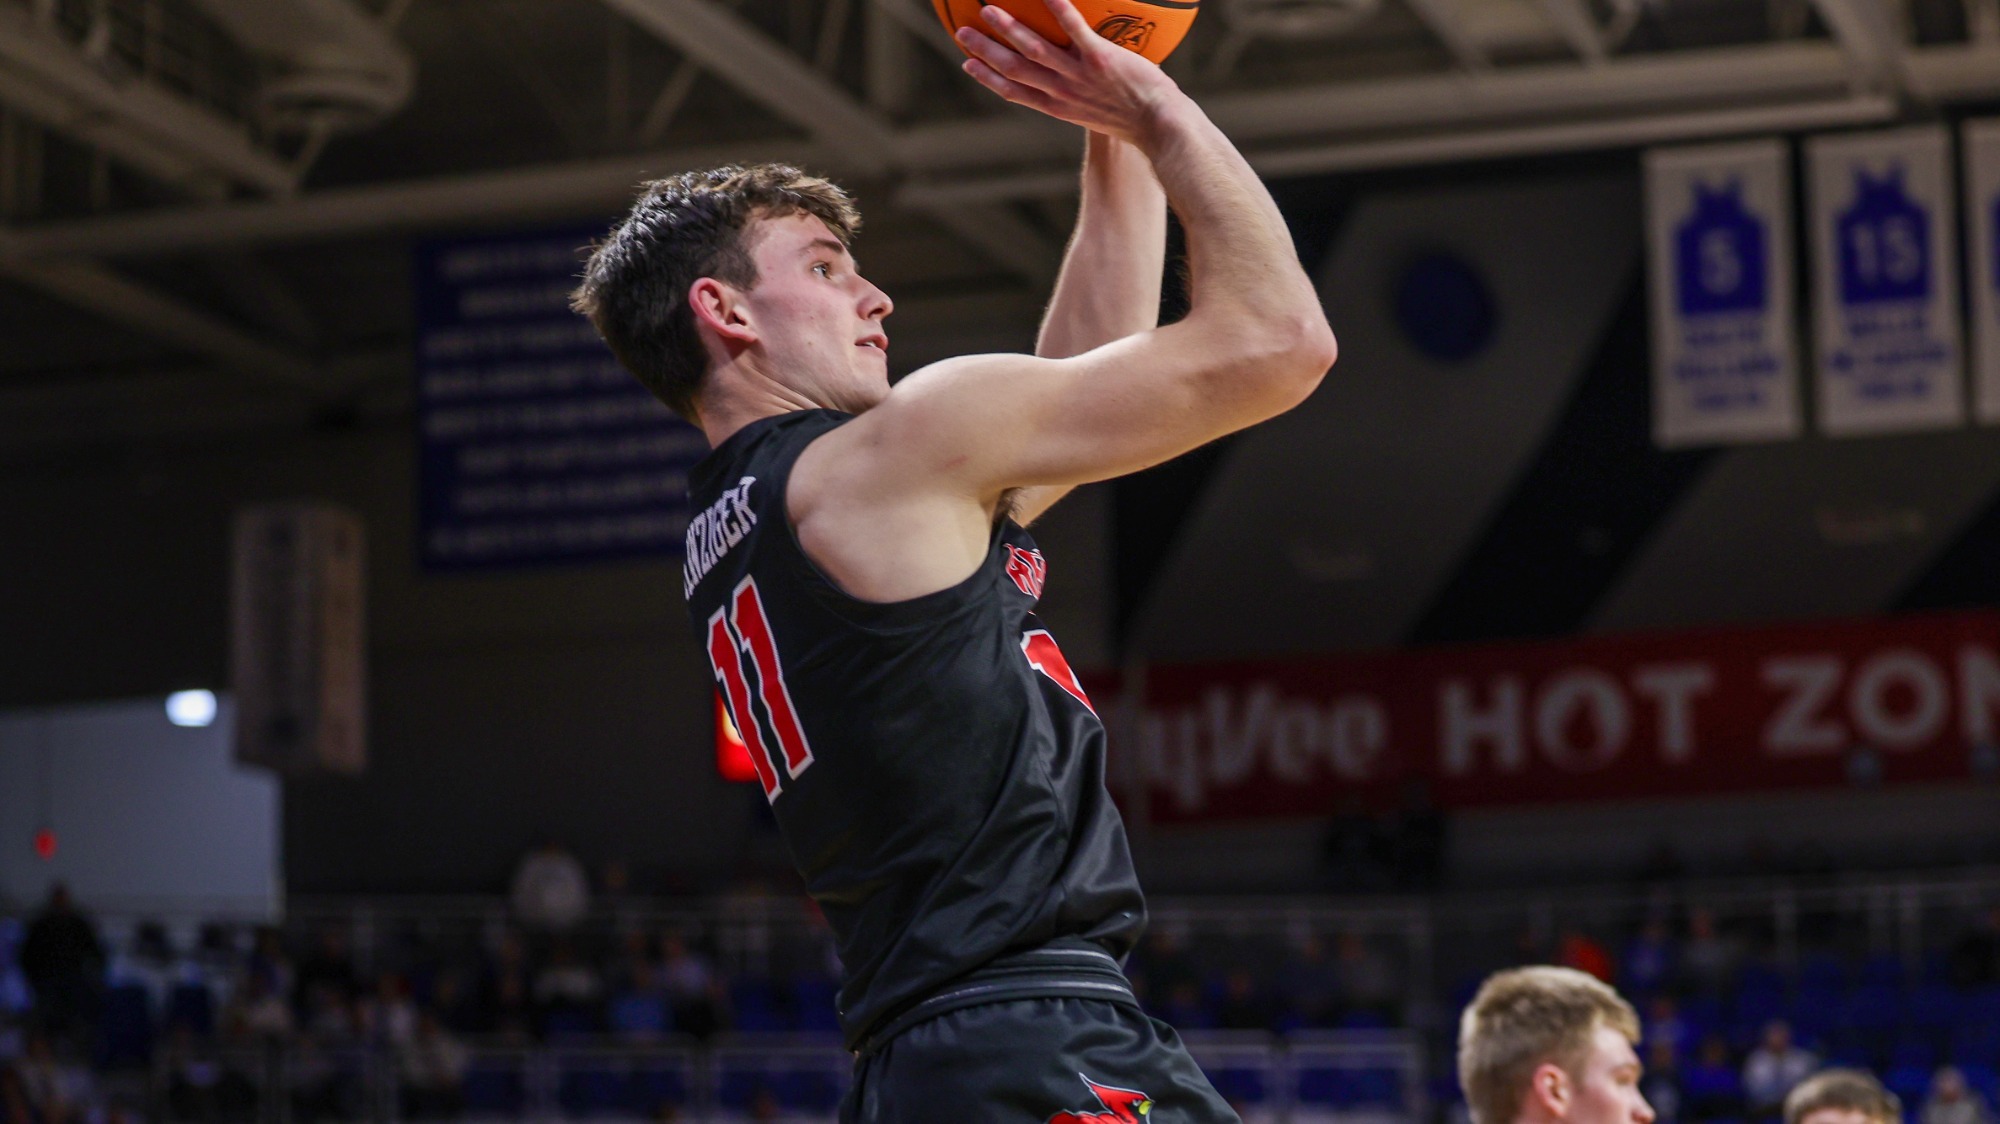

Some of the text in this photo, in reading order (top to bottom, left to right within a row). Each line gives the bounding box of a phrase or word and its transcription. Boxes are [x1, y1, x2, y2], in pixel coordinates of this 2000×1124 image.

[707, 573, 815, 806] 11
[1107, 682, 1388, 810] yVee
[1436, 663, 1718, 775] HOT
